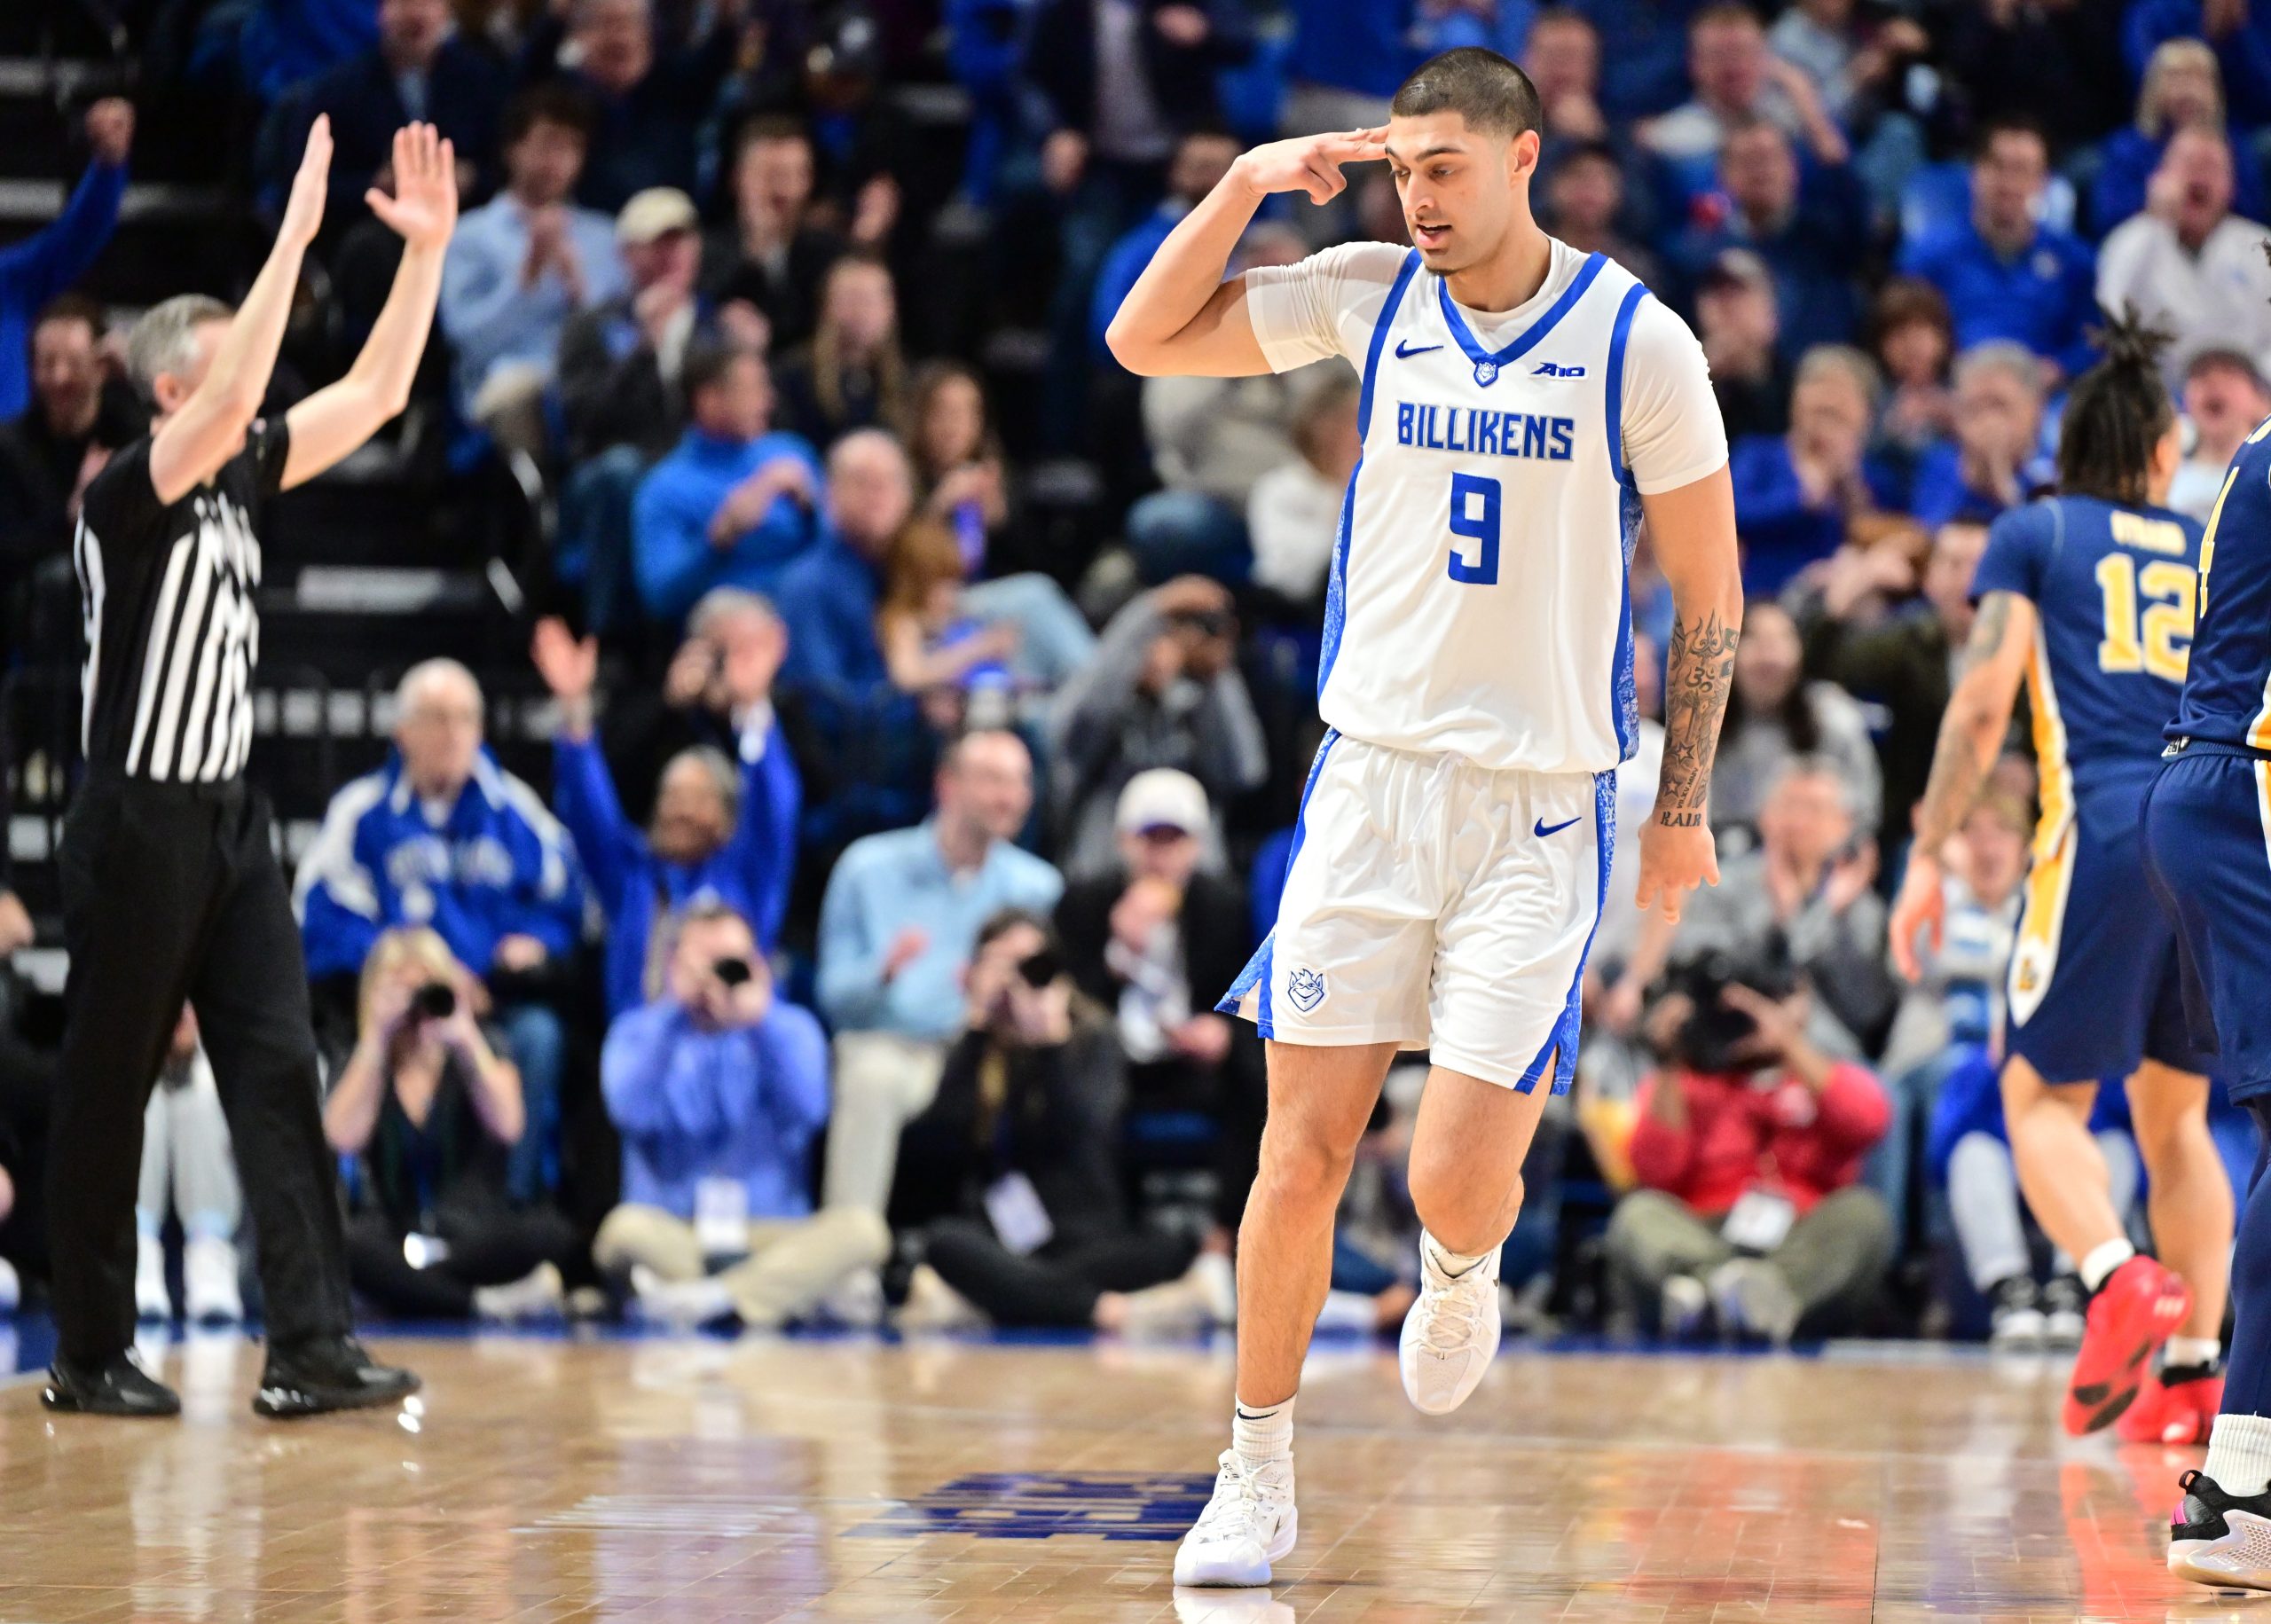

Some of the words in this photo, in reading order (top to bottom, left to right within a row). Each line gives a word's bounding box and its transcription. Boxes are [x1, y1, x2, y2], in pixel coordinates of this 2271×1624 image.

[1530, 362, 1585, 377] A10
[1397, 400, 1575, 461] BILLIKENS
[1448, 472, 1501, 584] 9
[2096, 553, 2197, 684] 12
